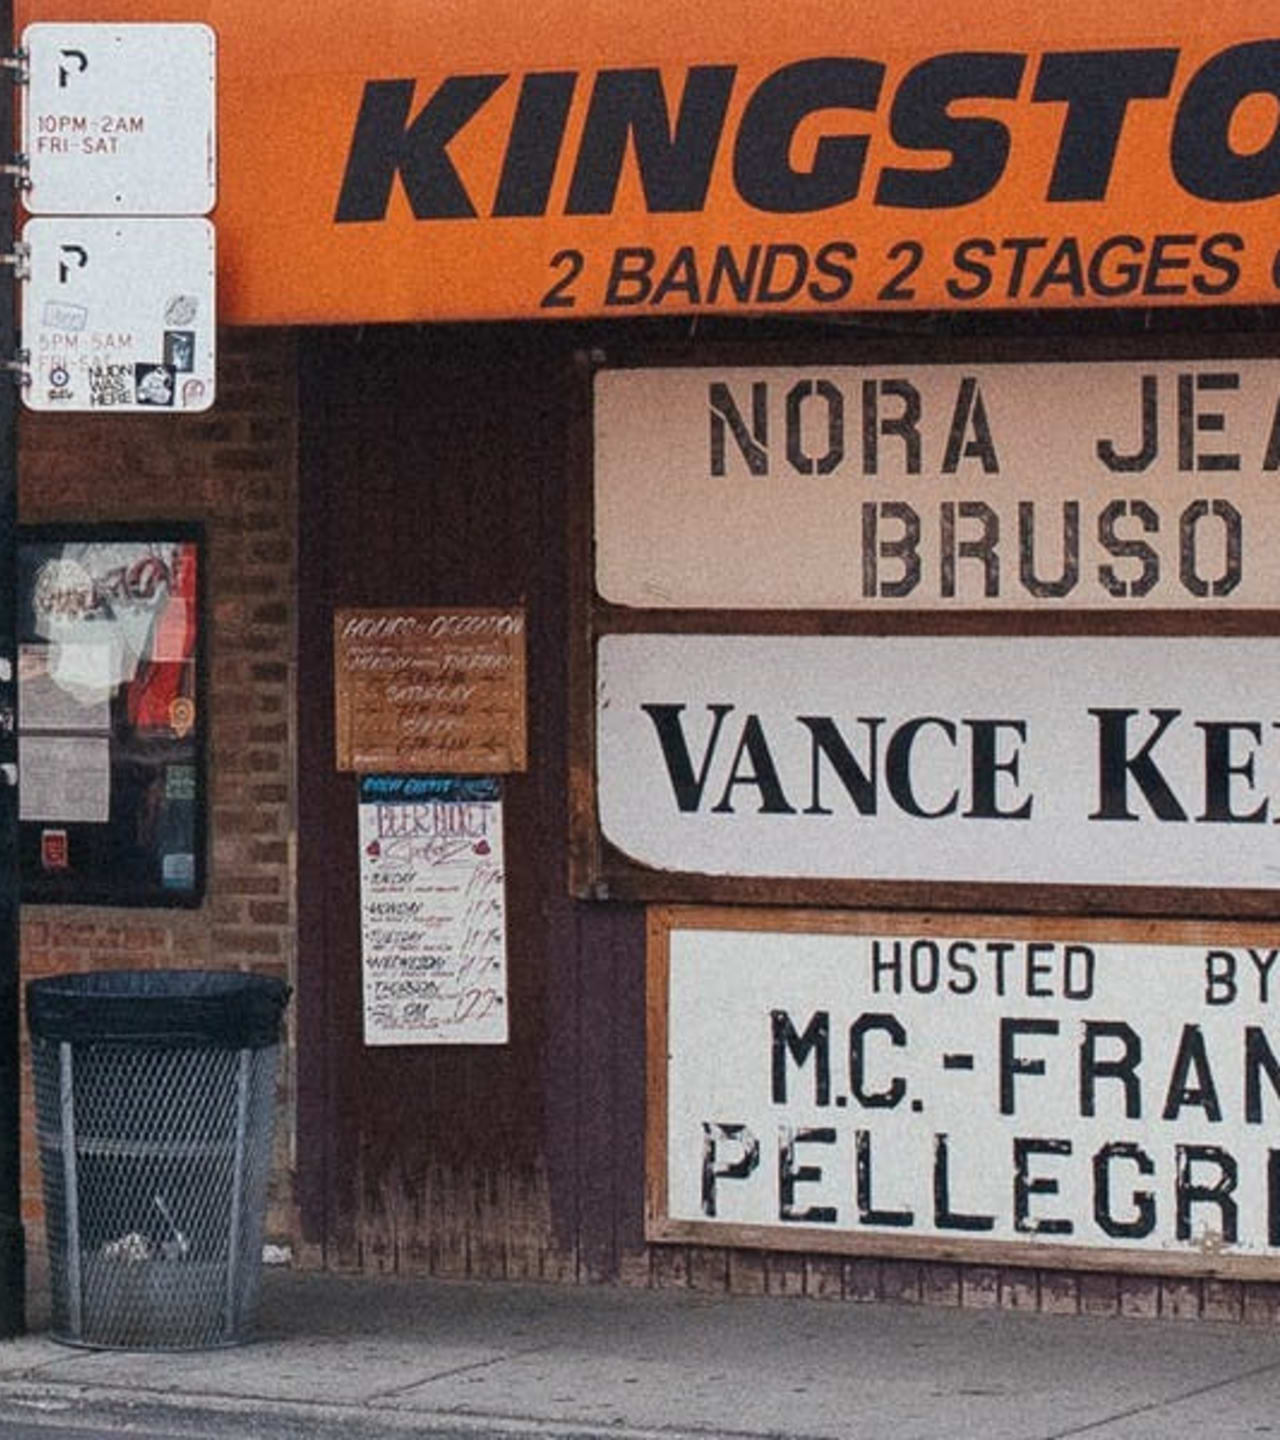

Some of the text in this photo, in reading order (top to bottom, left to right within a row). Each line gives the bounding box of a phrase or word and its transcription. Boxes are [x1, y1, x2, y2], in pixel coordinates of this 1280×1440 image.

[334, 39, 1280, 223] KINGSTO
[540, 248, 585, 308] 2
[605, 241, 859, 307] BANDS
[877, 241, 924, 301] 2
[945, 232, 1245, 300] STAGES
[708, 375, 1001, 477] NORA
[860, 498, 1243, 600] BRUSO
[640, 702, 1280, 825] VANCE KE
[872, 939, 1280, 1006] HOSTED BY
